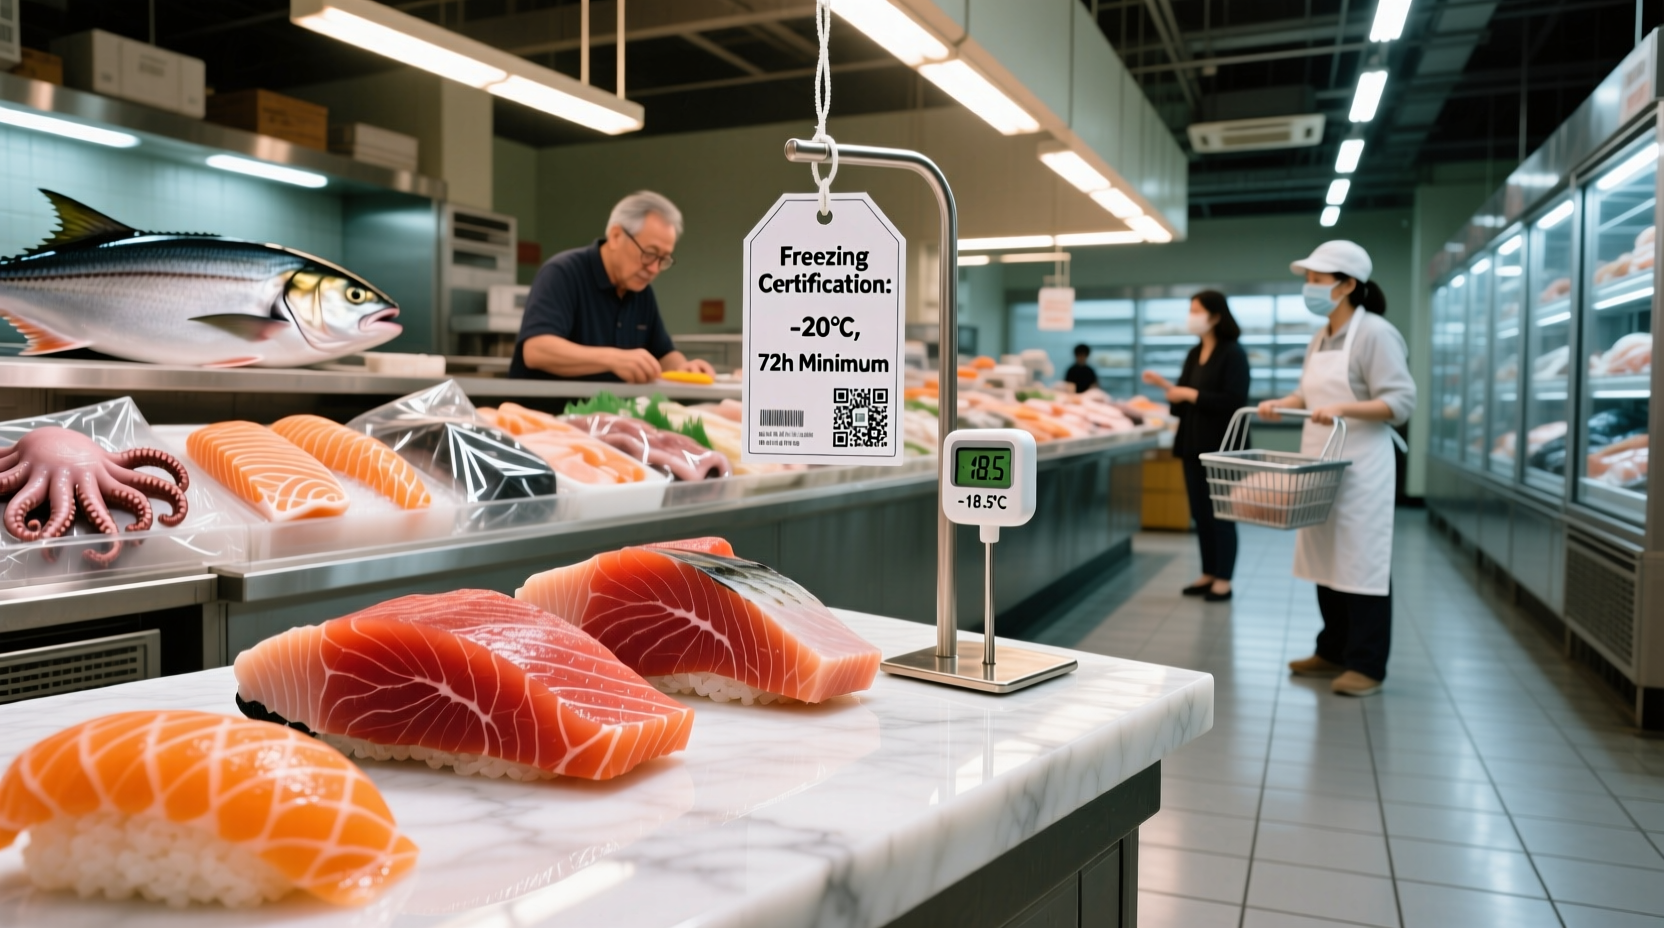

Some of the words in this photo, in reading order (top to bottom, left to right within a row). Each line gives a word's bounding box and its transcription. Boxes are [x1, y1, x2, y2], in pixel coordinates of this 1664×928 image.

[780, 246, 869, 271] Freezing
[758, 272, 892, 293] Certification:
[790, 316, 860, 341] -20°C,
[758, 353, 793, 371] 72h
[799, 353, 889, 373] Minimum
